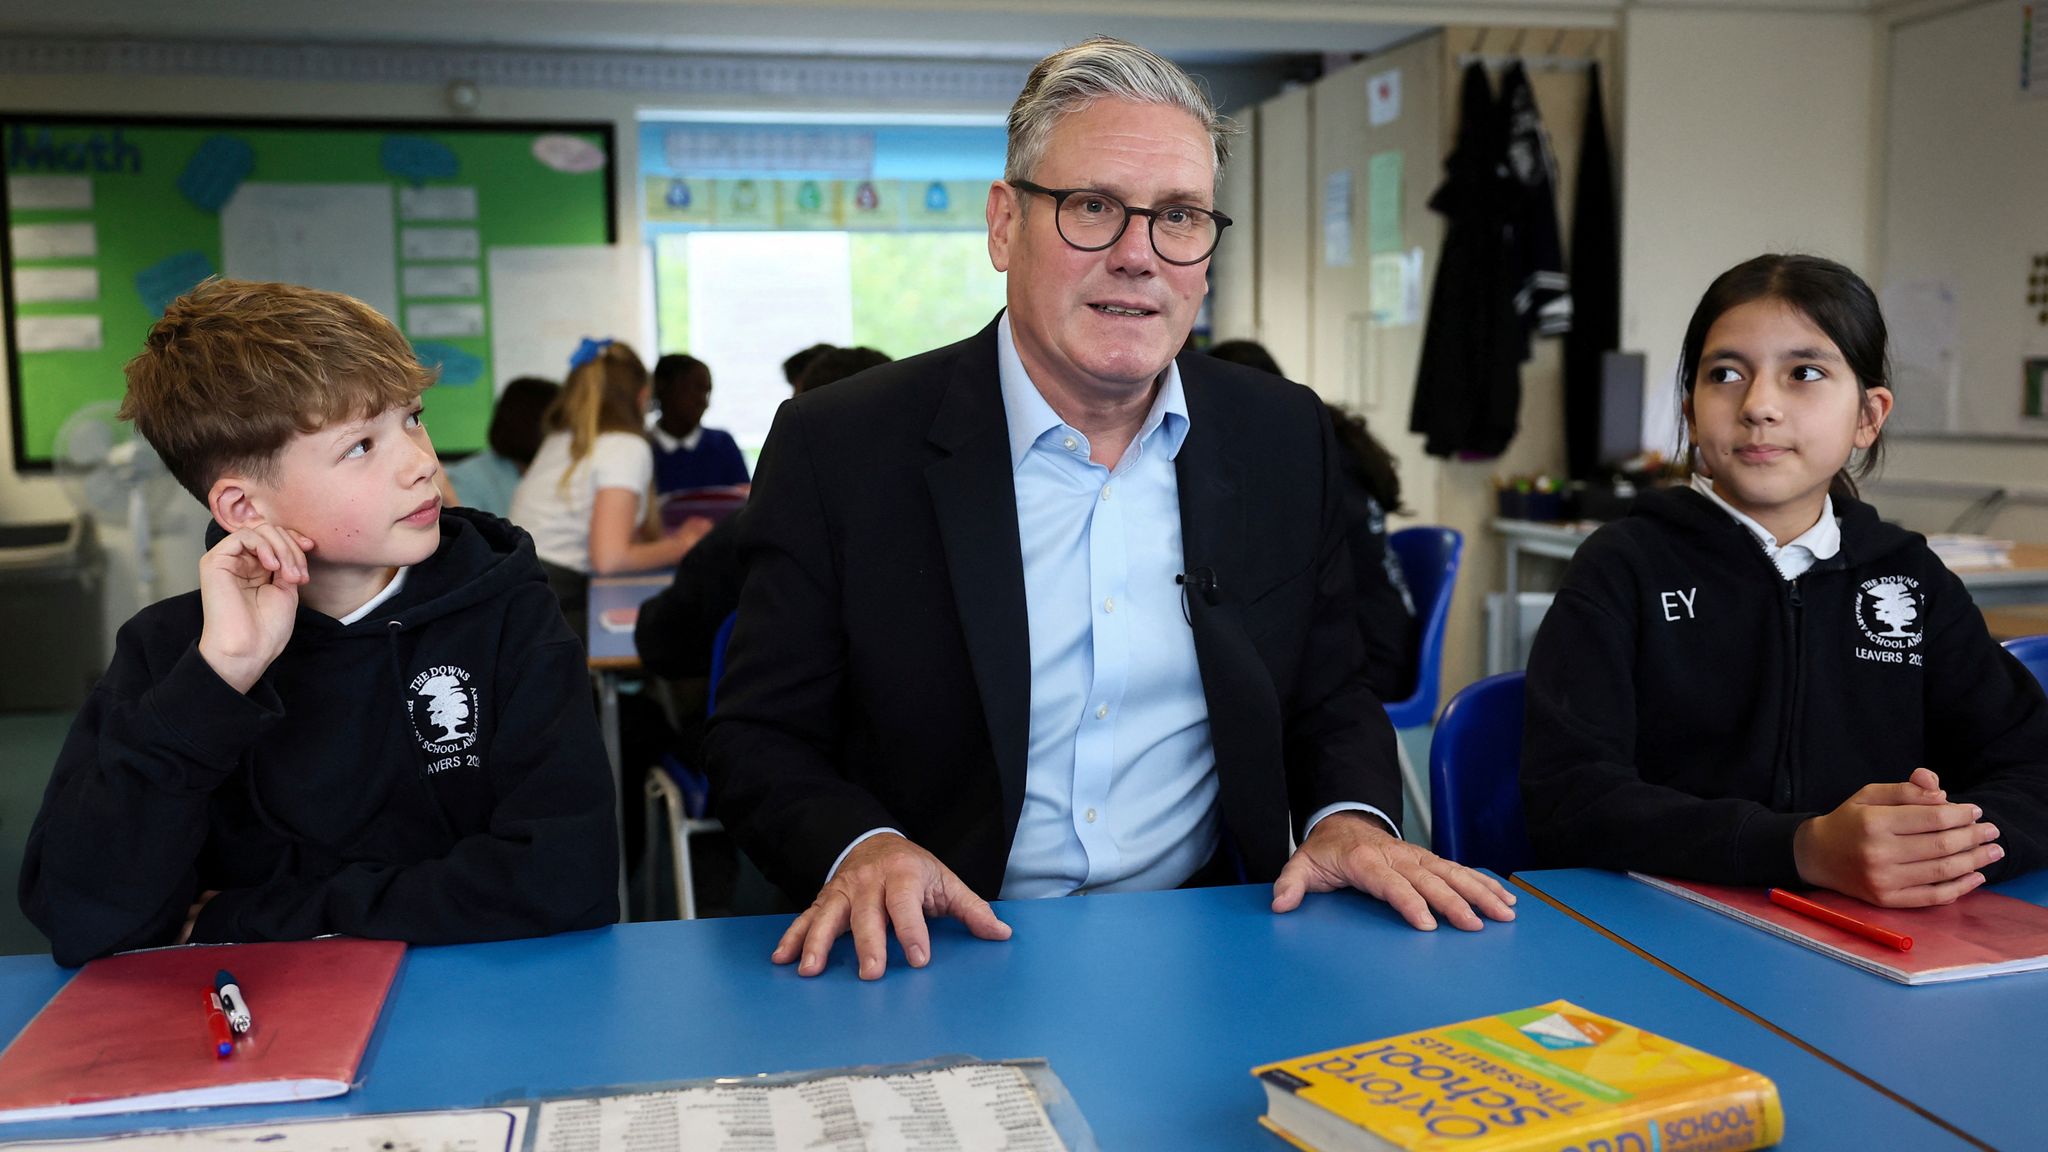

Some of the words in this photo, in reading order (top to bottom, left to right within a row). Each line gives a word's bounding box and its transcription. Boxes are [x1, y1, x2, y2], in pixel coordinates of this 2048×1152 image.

[10, 125, 142, 174] Math
[1860, 578, 1879, 591] THE
[1879, 575, 1920, 589] DOWNS
[1660, 586, 1697, 621] EY
[1855, 646, 1903, 663] LEAVERS
[1864, 630, 1906, 649] SCHOOL
[1907, 633, 1923, 648] AND
[410, 671, 430, 692] THE
[429, 665, 471, 682] DOWNS
[422, 740, 462, 754] SCHOOL
[463, 731, 478, 750] AND
[427, 755, 461, 776] AVERS
[1352, 1044, 1549, 1127] School
[1411, 1035, 1585, 1117] Thesaurus
[1300, 1055, 1488, 1139] Oxford
[1664, 1103, 1755, 1144] SCHOOL
